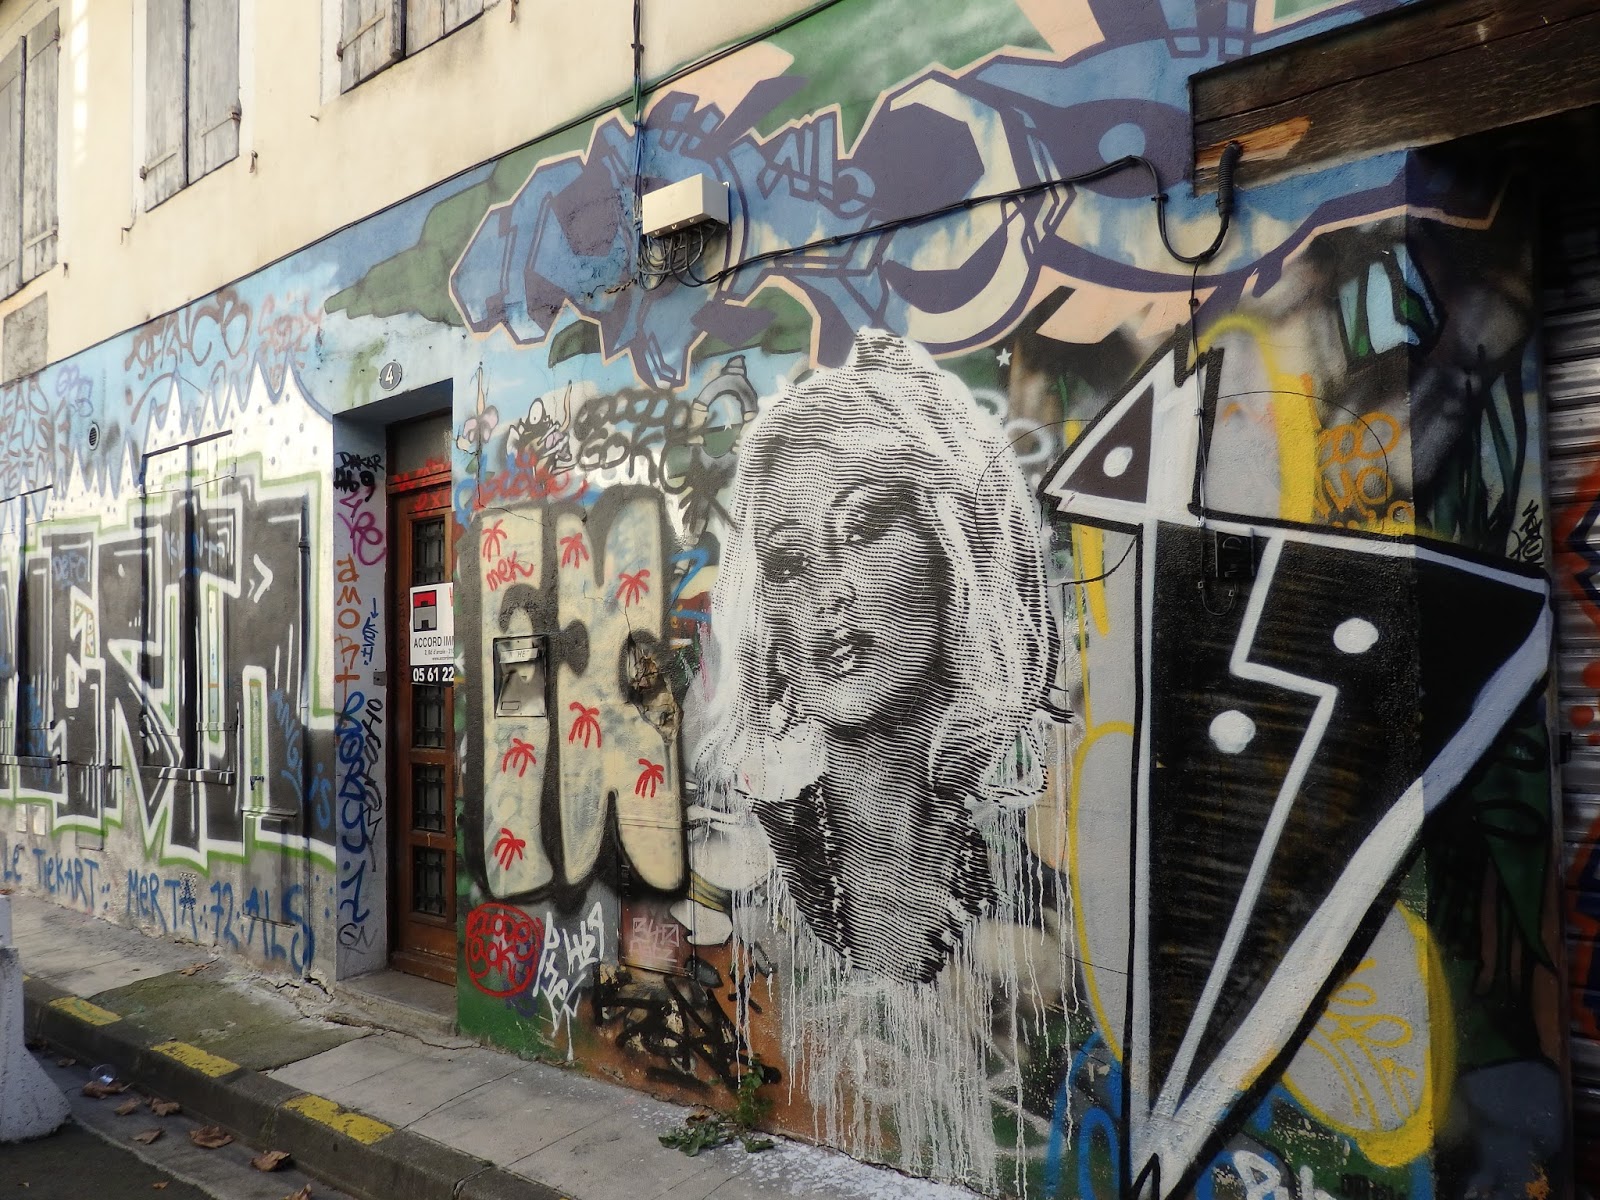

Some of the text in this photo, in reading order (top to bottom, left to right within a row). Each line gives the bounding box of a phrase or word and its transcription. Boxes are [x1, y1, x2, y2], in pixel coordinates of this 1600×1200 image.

[385, 365, 394, 385] 4
[413, 637, 441, 648] ACCORD
[412, 666, 455, 682] 05 61 22
